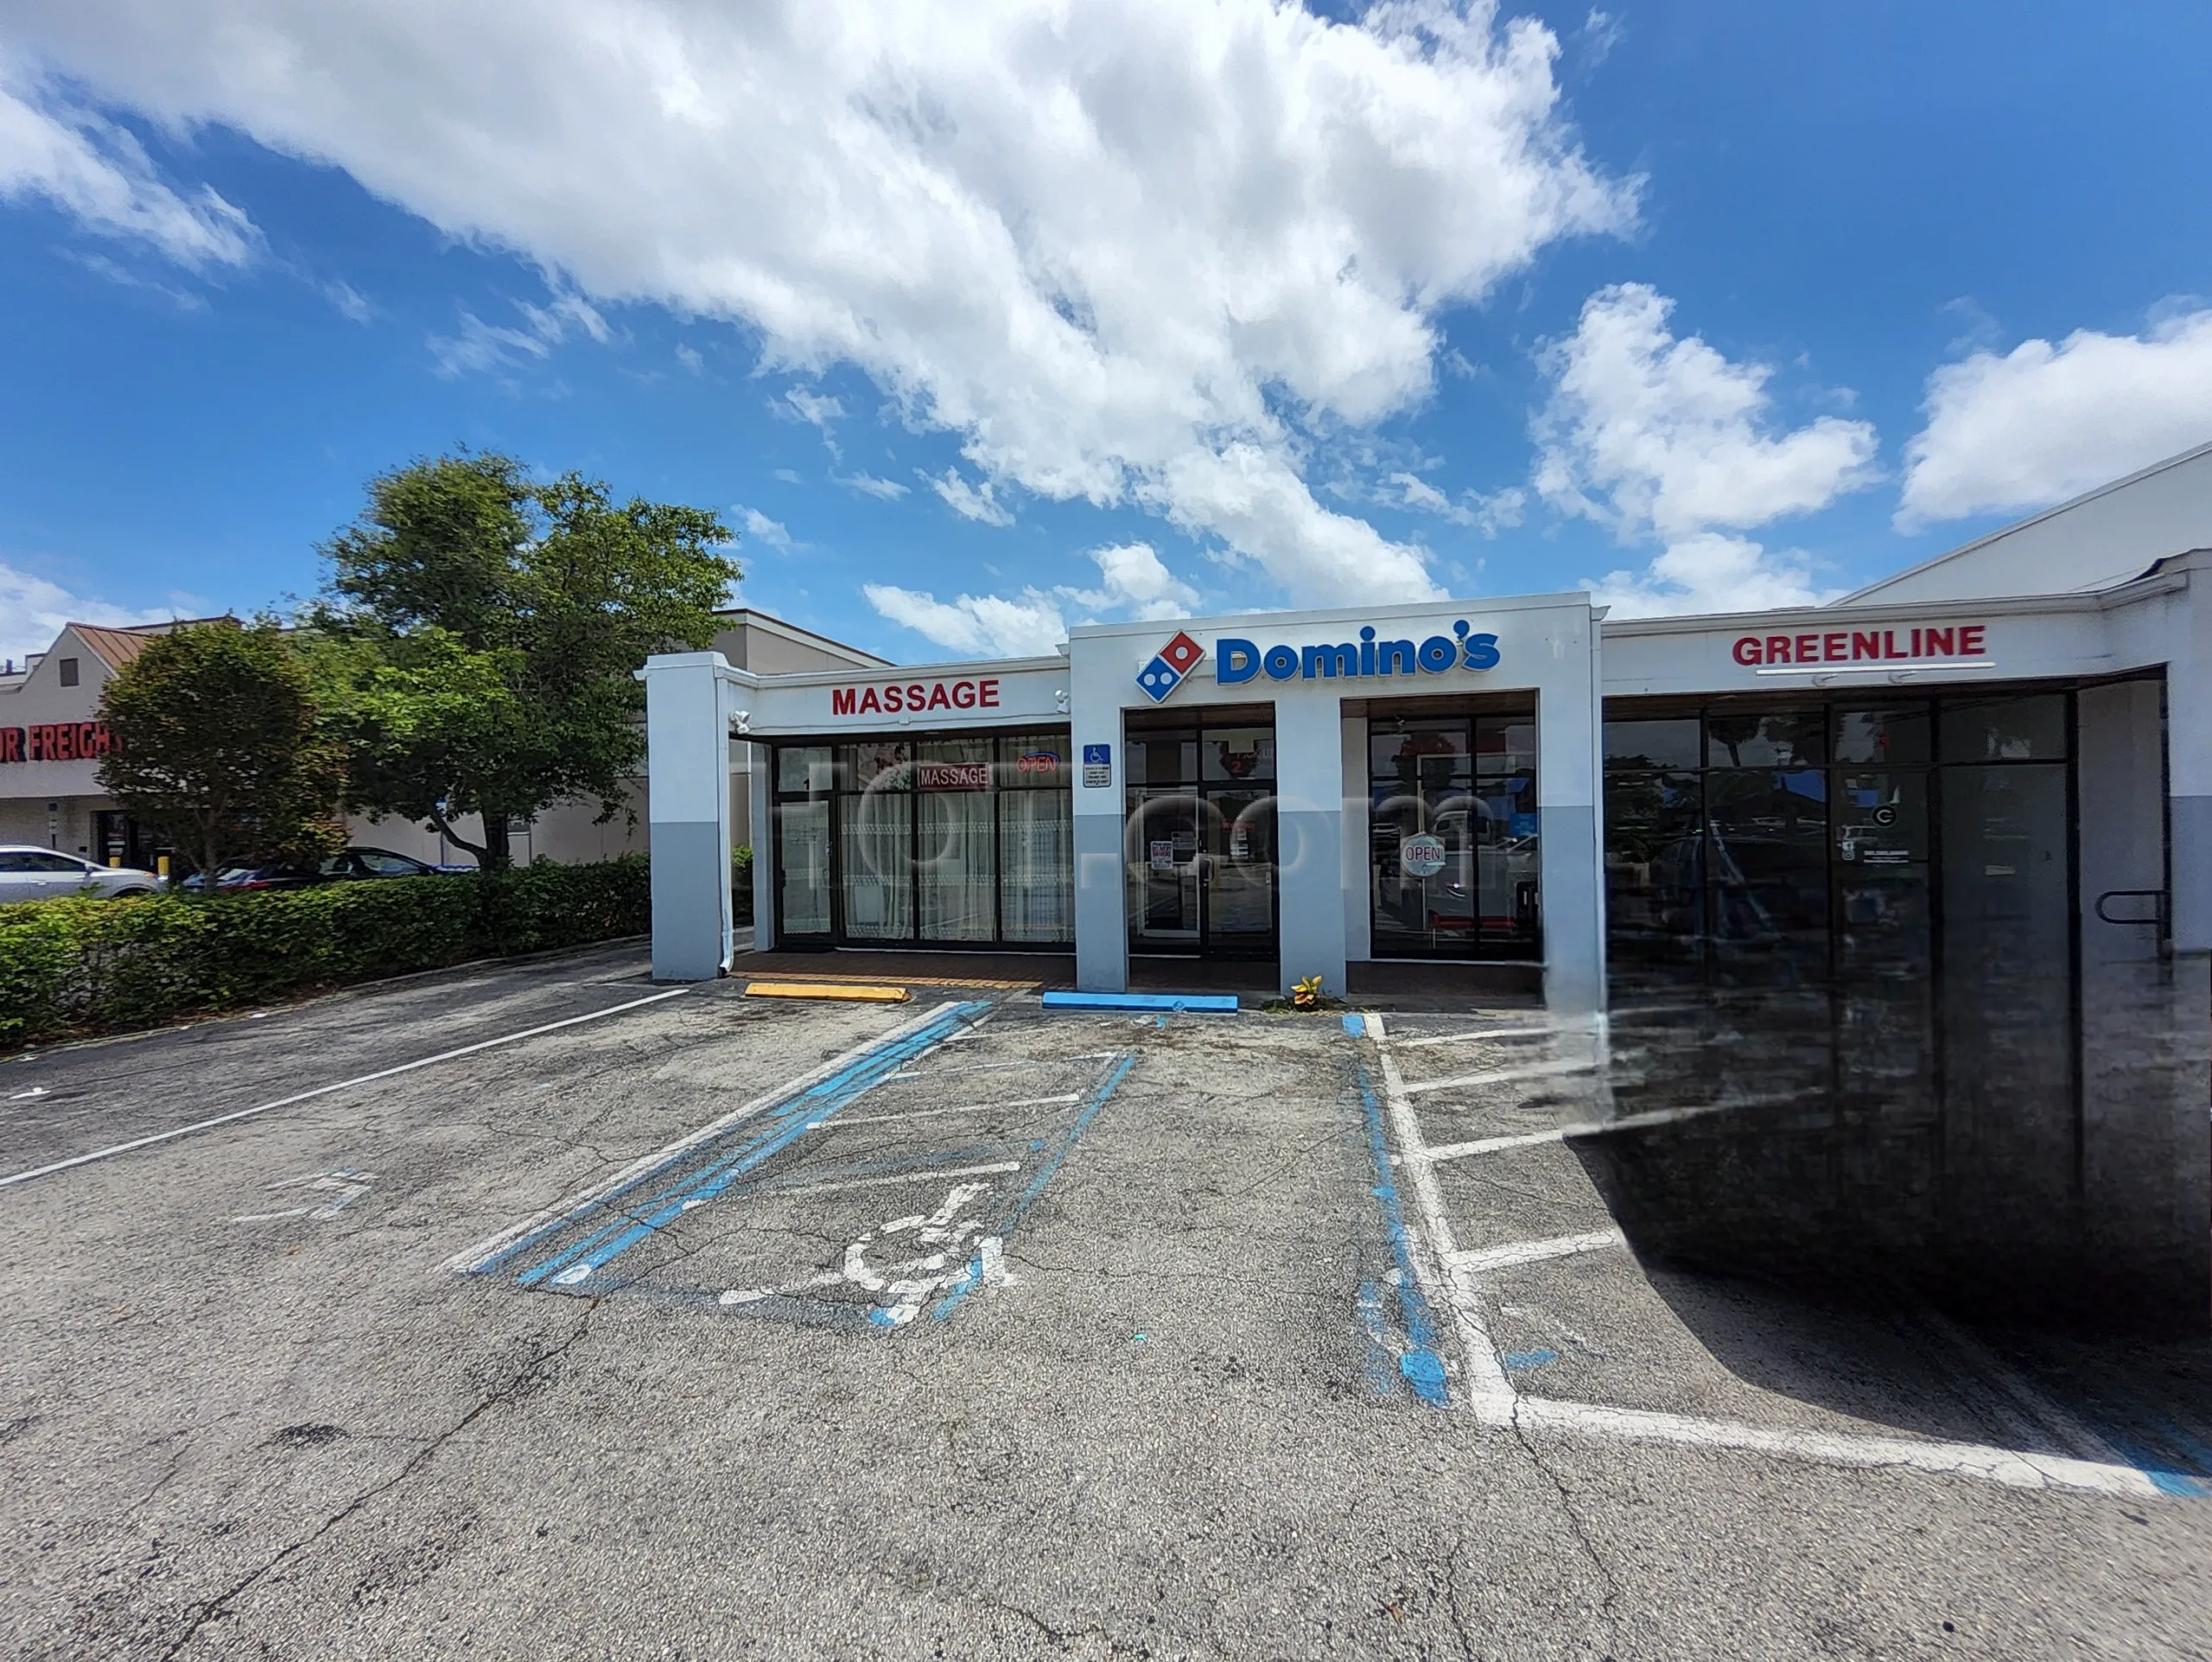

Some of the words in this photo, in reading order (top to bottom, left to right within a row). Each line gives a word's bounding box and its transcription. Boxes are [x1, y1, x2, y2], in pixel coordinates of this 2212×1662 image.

[1216, 620, 1500, 685] Domino's
[1732, 626, 1986, 665] GREENLINE
[832, 679, 999, 716] MASSAGE
[921, 767, 988, 786] MASSAGE
[1015, 757, 1057, 773] OPEN
[1405, 846, 1441, 862] OPEN
